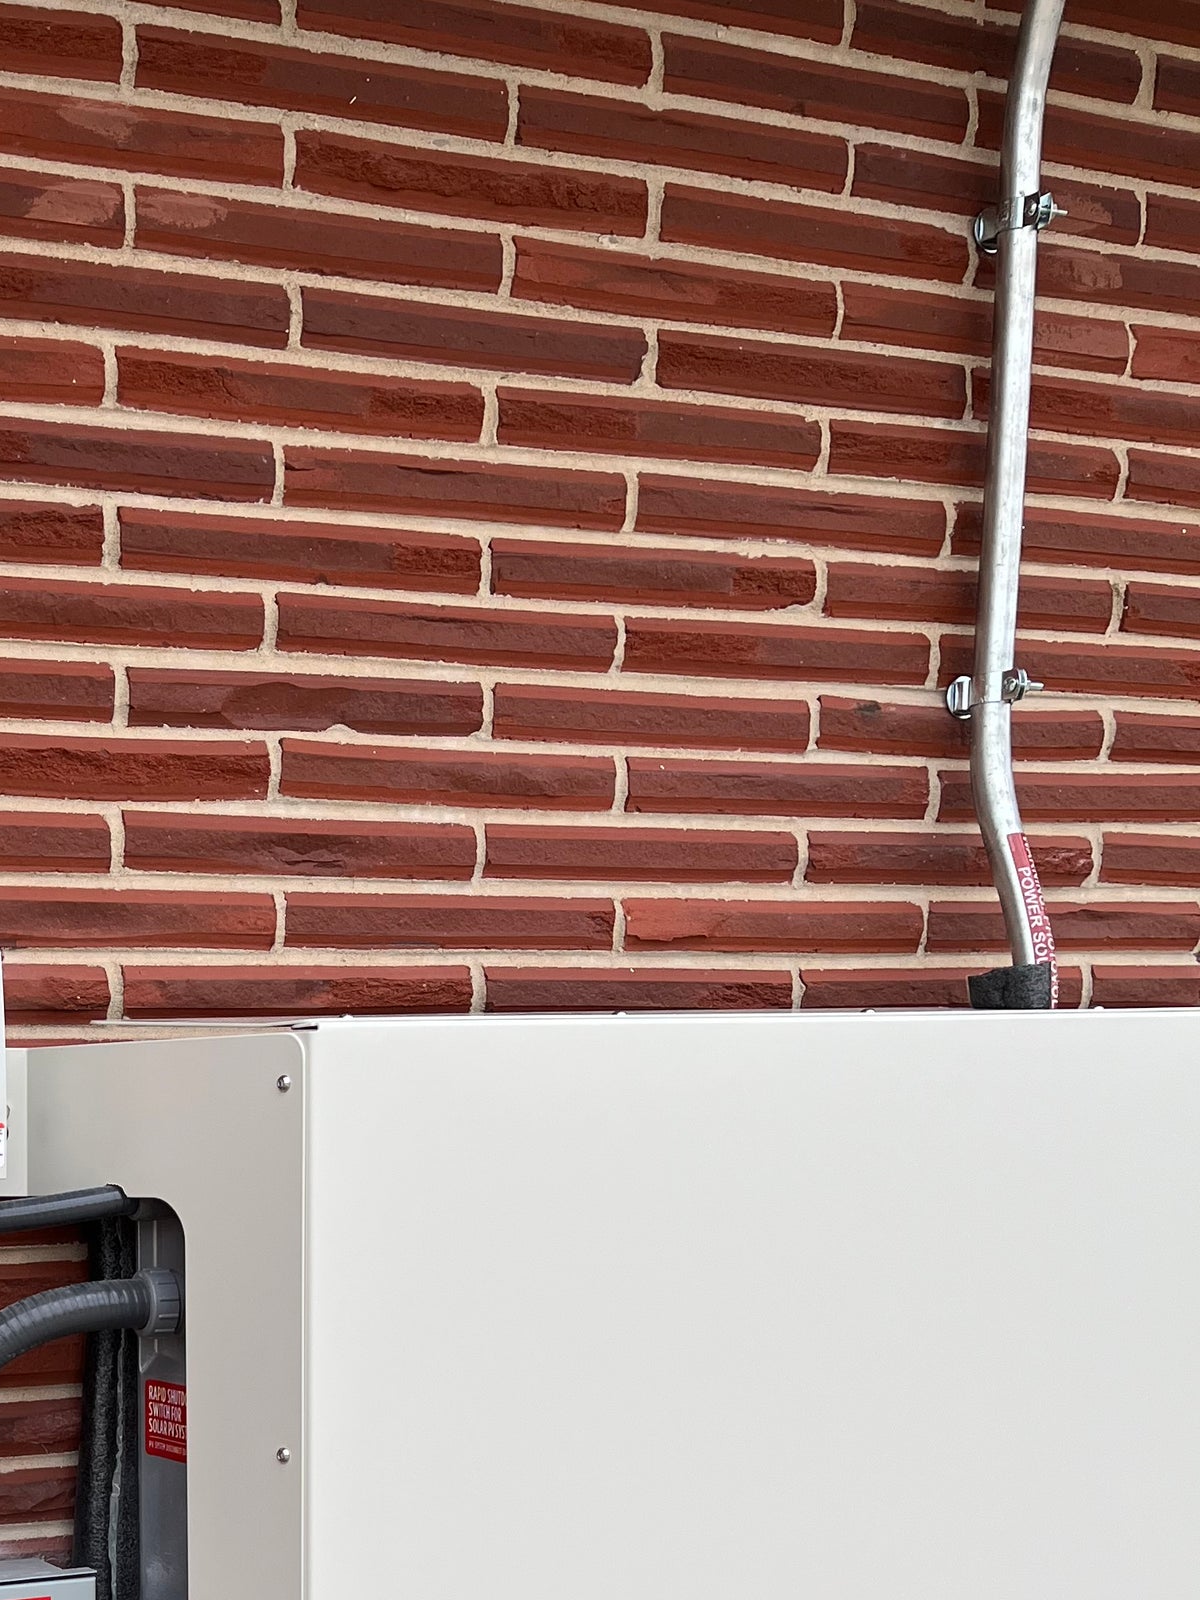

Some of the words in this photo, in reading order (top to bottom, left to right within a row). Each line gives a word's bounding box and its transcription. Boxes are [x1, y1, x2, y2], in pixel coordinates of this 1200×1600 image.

[1017, 866, 1043, 928] POWER
[148, 1385, 166, 1403] RAPID
[148, 1401, 171, 1420] SWITCH
[171, 1406, 182, 1423] FOR
[148, 1418, 167, 1436] SOLAR
[168, 1421, 175, 1437] PV
